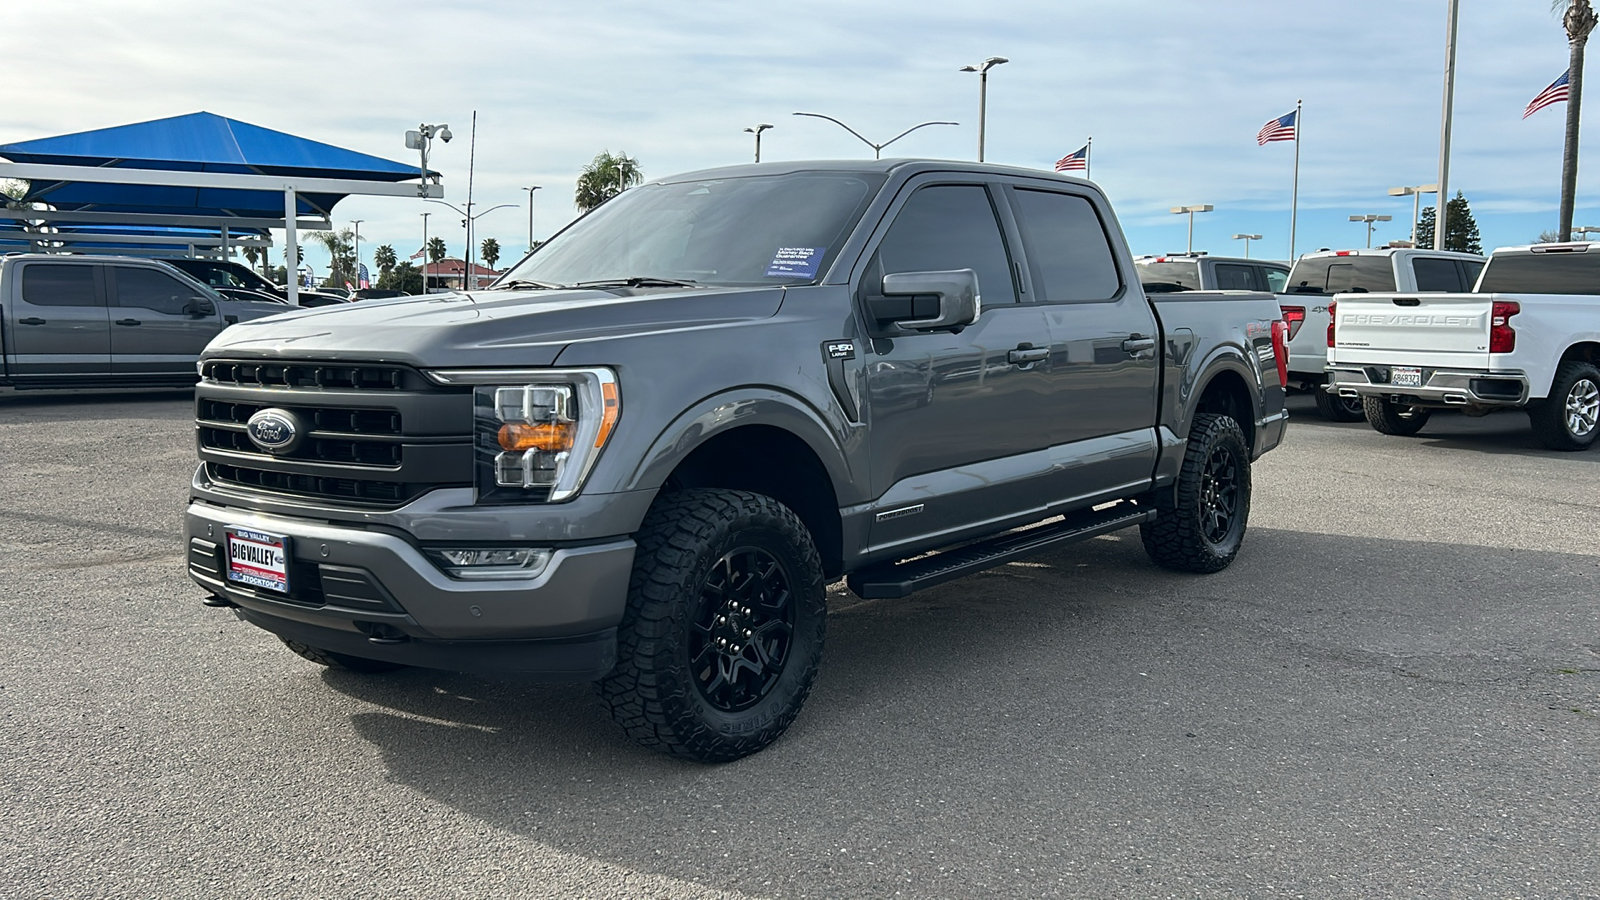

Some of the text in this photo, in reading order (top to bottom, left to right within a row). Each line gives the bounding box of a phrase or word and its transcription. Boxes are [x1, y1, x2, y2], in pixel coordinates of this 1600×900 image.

[1342, 313, 1478, 326] CHEVROLET
[828, 344, 854, 353] F-150
[256, 420, 281, 440] Ford
[237, 530, 271, 542] BIG VALLEY
[232, 542, 274, 566] BIGVALLEY
[241, 574, 278, 588] STOCKTON
